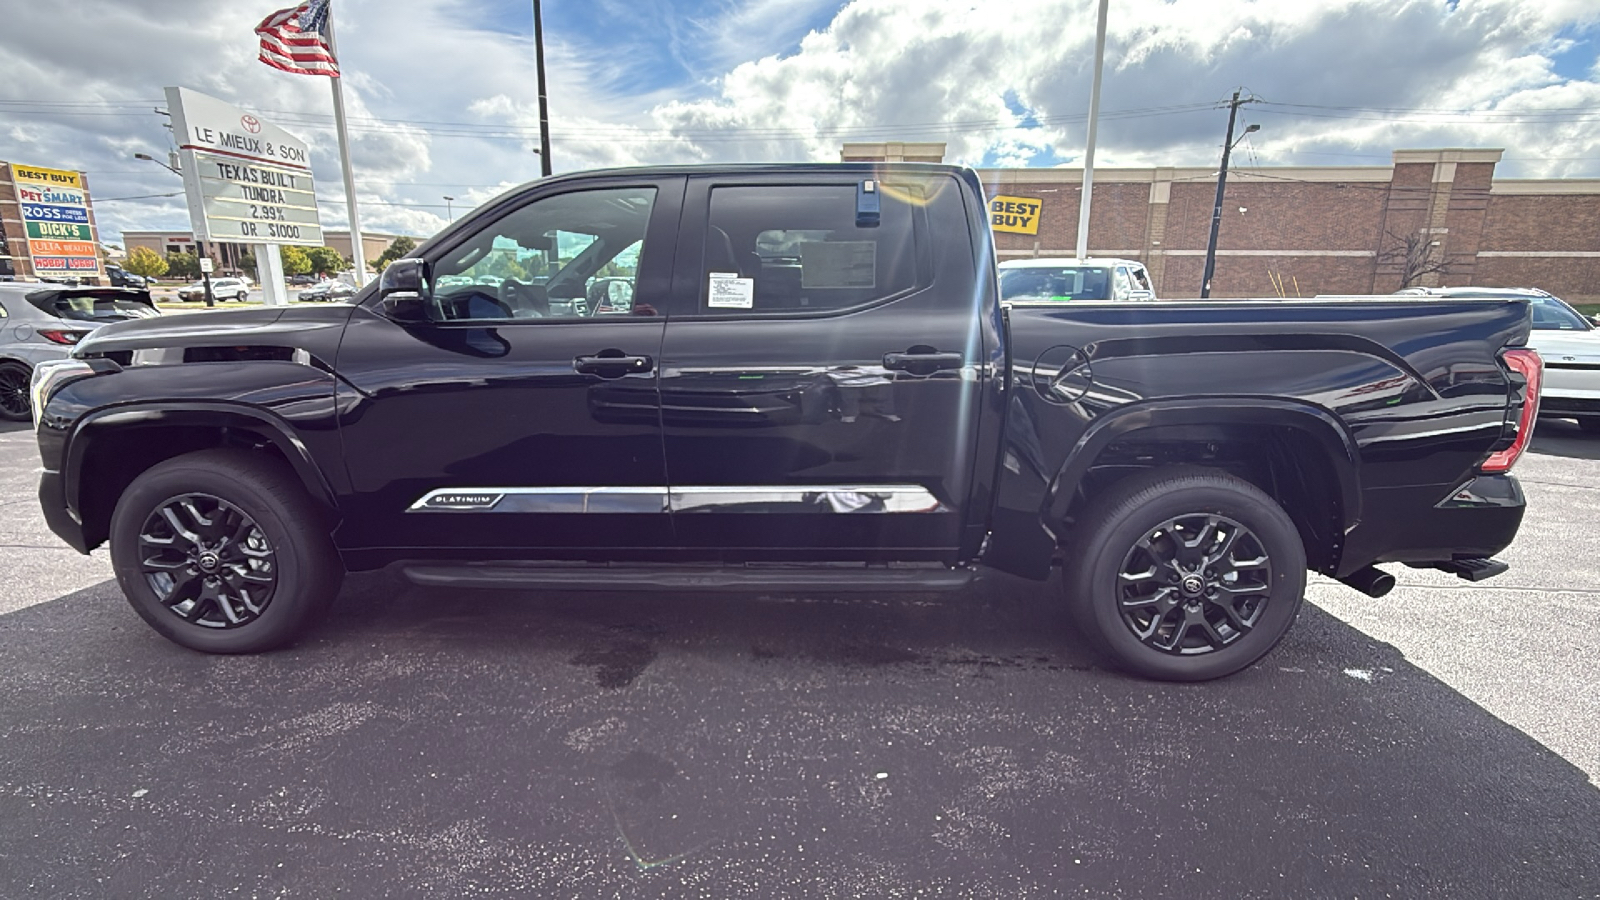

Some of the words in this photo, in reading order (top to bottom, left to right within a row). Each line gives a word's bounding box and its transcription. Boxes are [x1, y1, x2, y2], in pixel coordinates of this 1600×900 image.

[195, 126, 214, 144] LE
[219, 131, 262, 153] MIEUX
[266, 143, 275, 155] &
[280, 145, 305, 162] SON
[18, 169, 48, 180] BEST
[51, 173, 76, 183] BUY
[217, 163, 258, 183] TEXAS
[261, 170, 296, 188] BUILT
[241, 186, 285, 204] TUNDRA
[23, 206, 60, 218] ROSS
[250, 205, 285, 220] 2.99%
[991, 201, 1039, 215] BEST
[991, 214, 1032, 227] BUY
[39, 223, 80, 236] DICK'S
[241, 222, 258, 236] OR
[34, 242, 61, 251] ULTA
[63, 244, 93, 253] BEAUTY
[34, 257, 66, 268] HOBBY
[68, 257, 95, 269] LOBBY
